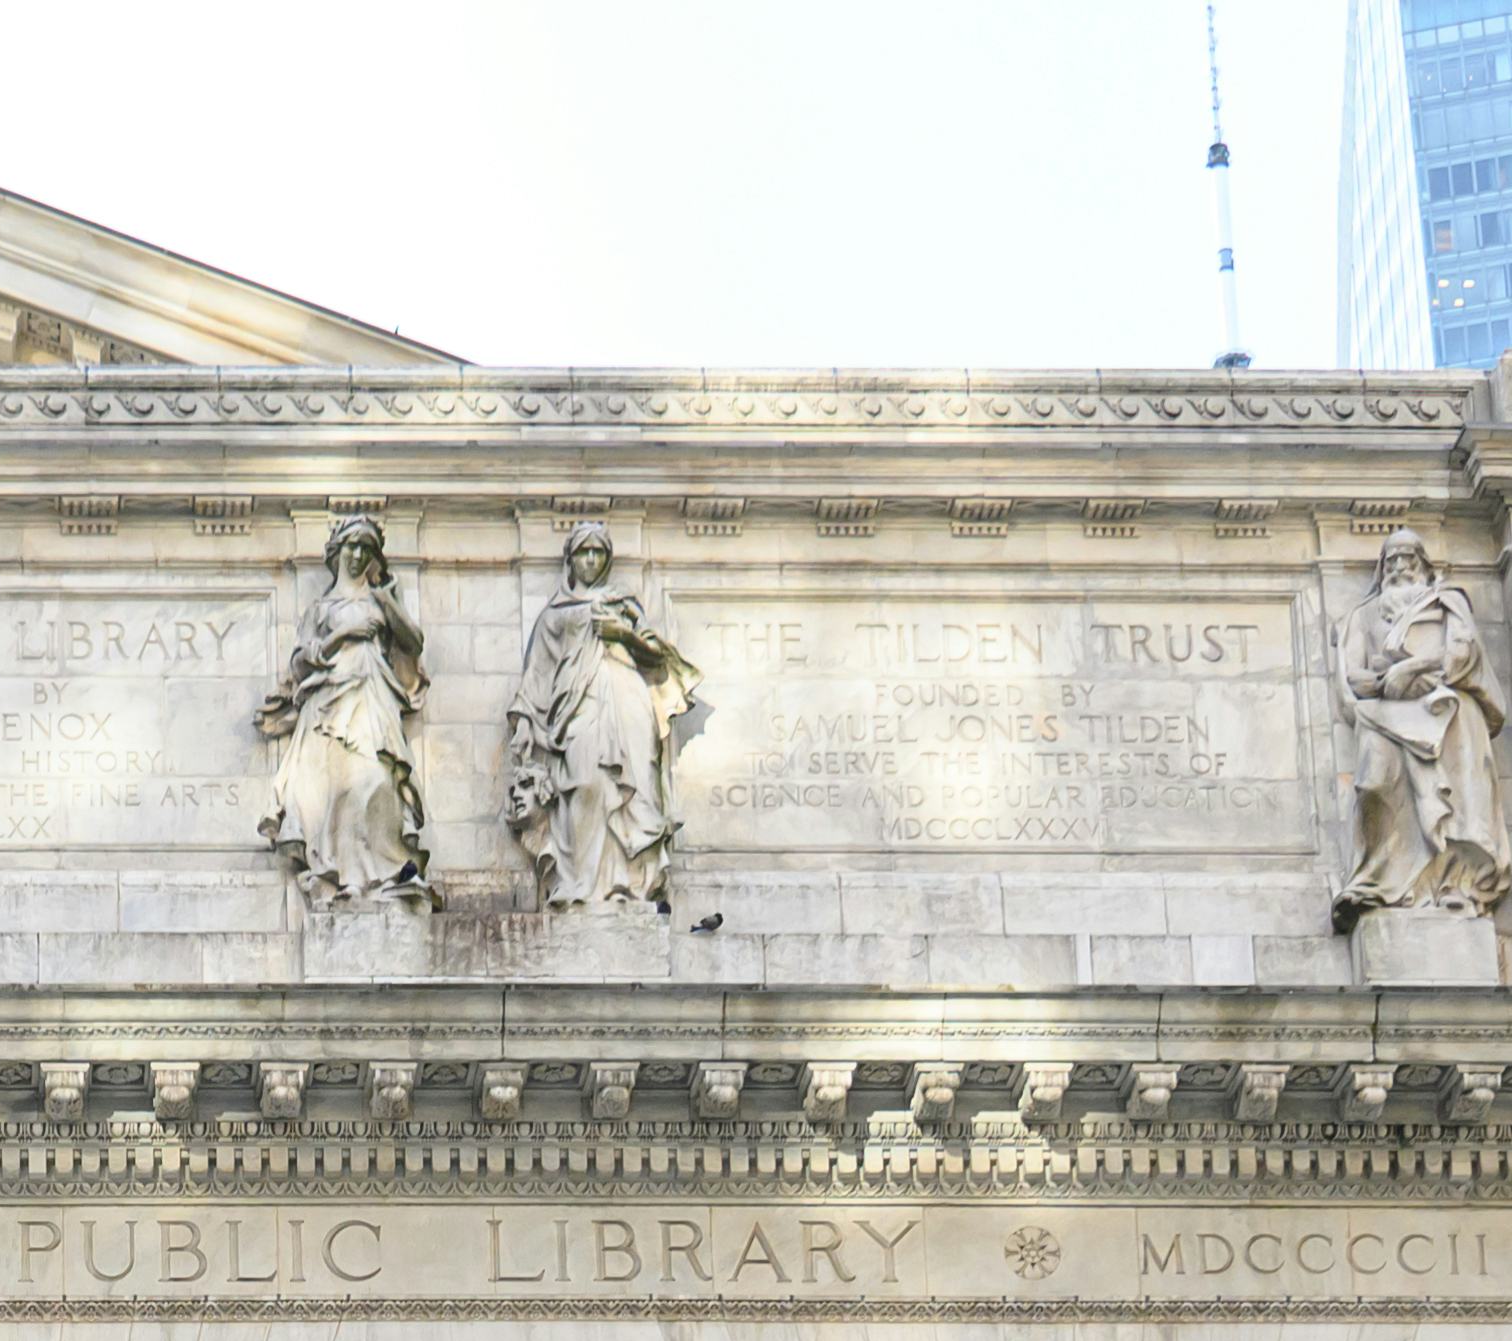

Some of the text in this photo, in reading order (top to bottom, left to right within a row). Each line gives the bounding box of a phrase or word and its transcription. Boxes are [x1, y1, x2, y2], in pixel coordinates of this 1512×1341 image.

[16, 621, 237, 661] LIBRARY
[706, 623, 1260, 663] THE TILDEN TRUST
[33, 681, 70, 704] BY
[876, 684, 1095, 707] FOUNDED BY
[771, 714, 1211, 744] SAMUEL JONES TILDEN
[746, 752, 1227, 775] TO SERVE THE INTERESTS OF
[72, 784, 141, 806] FINE
[160, 784, 240, 806] ARTS
[709, 784, 1277, 808] SCIENCE AND POPULAR EDUCATION
[18, 1219, 383, 1283] PUBLIC
[486, 1218, 923, 1283] LIBRARY
[1141, 1232, 1490, 1276] MDCCCCII
